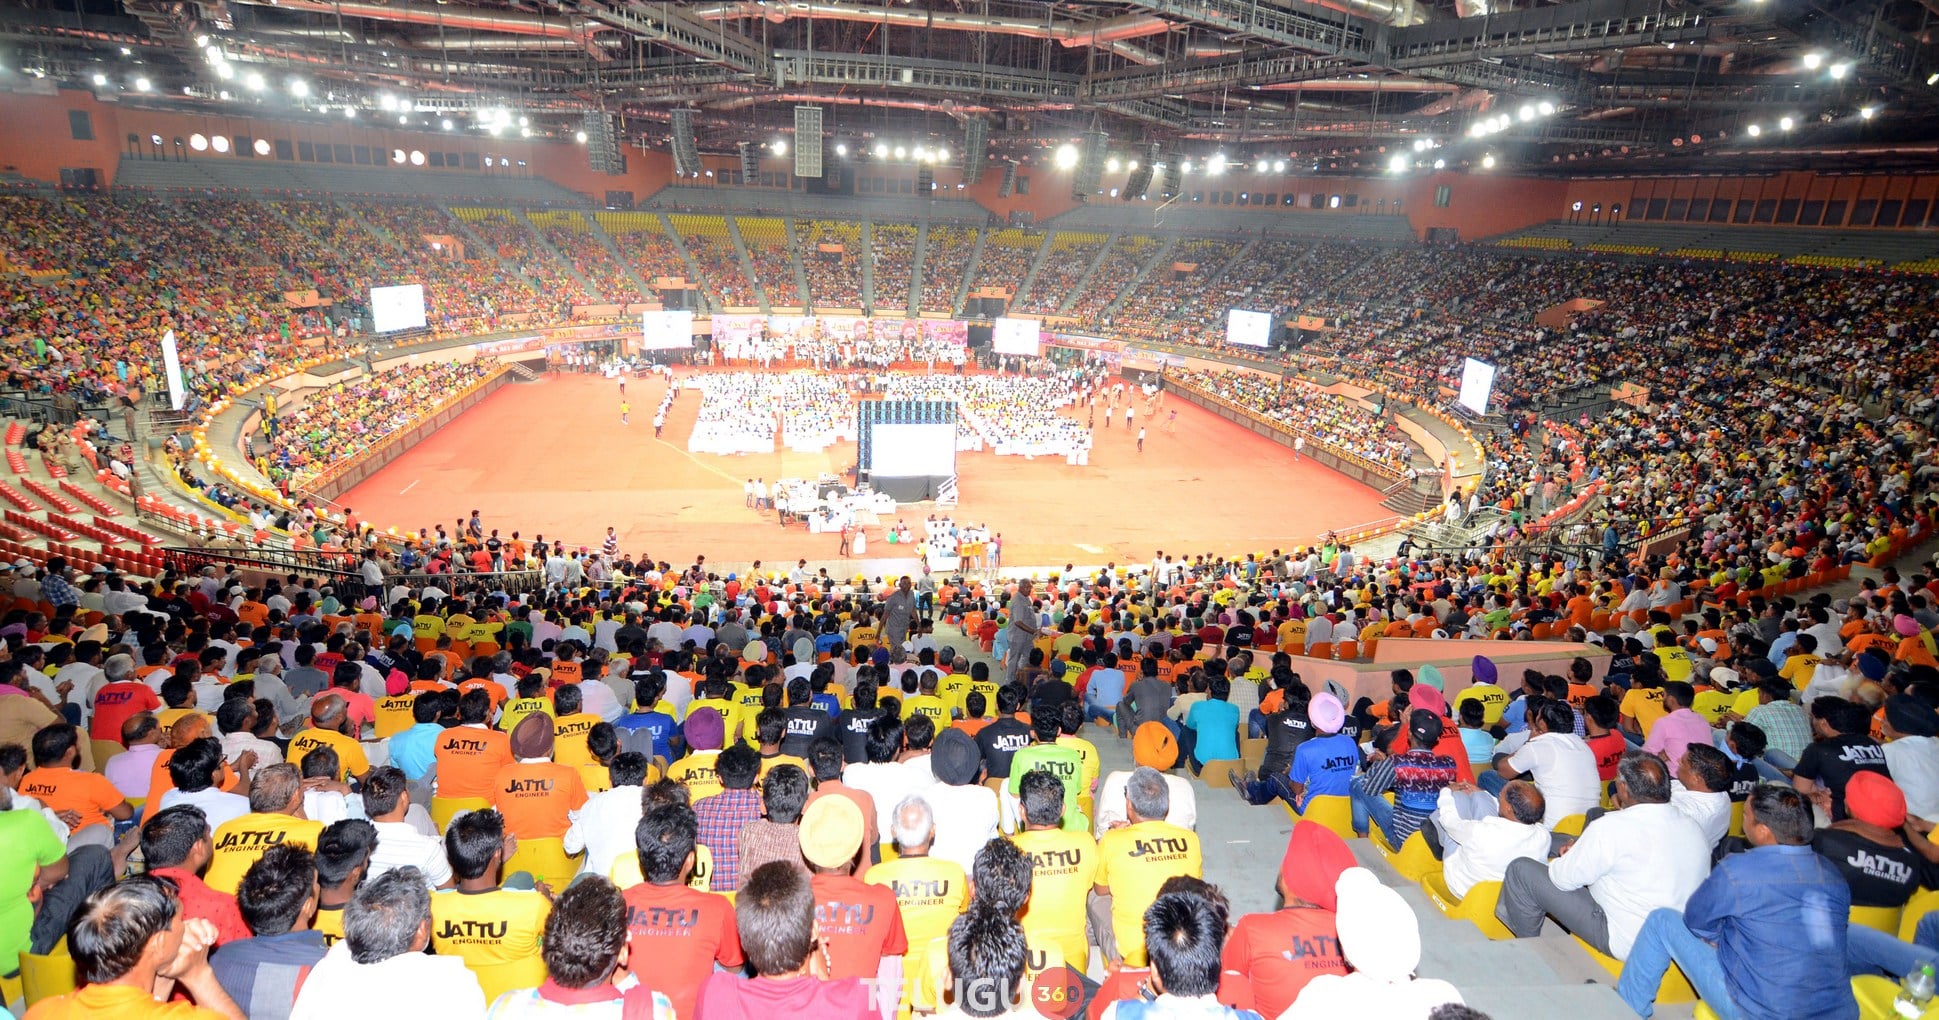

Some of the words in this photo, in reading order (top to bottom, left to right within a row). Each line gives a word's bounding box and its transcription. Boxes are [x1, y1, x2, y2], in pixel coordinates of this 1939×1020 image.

[381, 700, 413, 708] JATTU
[1481, 694, 1504, 702] JATTU
[554, 722, 591, 737] JATTU
[786, 718, 816, 730] ATTU
[443, 738, 487, 751] JATTU
[993, 735, 1028, 749] JATTU
[1839, 745, 1883, 760] JATTU
[1321, 756, 1354, 769] JATTU
[684, 768, 717, 780] JATT
[25, 784, 56, 793] JATTU
[505, 779, 555, 794] JATTU
[215, 831, 287, 850] JATTU
[1128, 838, 1188, 858] JATTU
[1145, 854, 1187, 863] ENGINEER
[1847, 850, 1912, 880] JATTU
[1034, 866, 1079, 877] ENGINEER
[815, 905, 874, 925] ATTU
[436, 920, 508, 938] JATTU
[818, 926, 867, 935] NGINEER
[452, 937, 502, 945] ENGINEER
[1281, 935, 1342, 960] JATT
[1304, 959, 1345, 969] ENGINE
